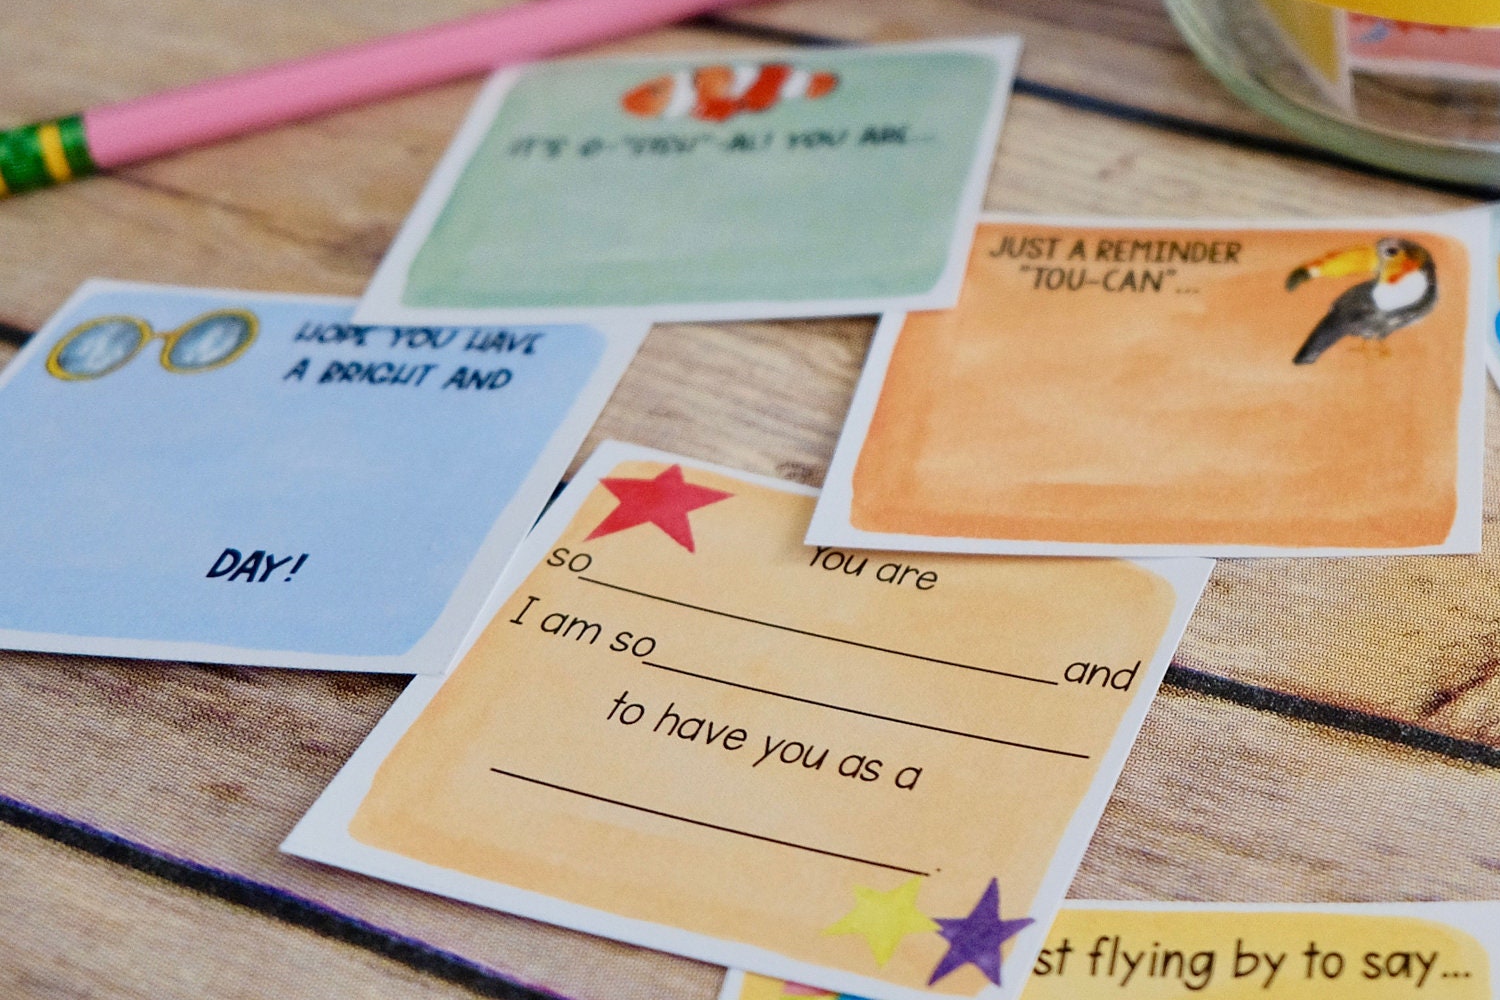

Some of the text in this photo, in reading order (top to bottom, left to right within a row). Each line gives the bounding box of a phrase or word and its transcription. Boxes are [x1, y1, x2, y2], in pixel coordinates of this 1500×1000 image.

[990, 235, 1243, 265] JUST A REMINDER
[390, 326, 458, 349] YOU
[463, 328, 546, 355] HAVE
[283, 356, 513, 390] A BRIGHT AND
[206, 547, 310, 583] DAY!
[810, 545, 938, 590] You are
[509, 595, 657, 659] I am so
[546, 545, 1142, 692] so and
[606, 690, 923, 792] to have you as a
[1087, 934, 1217, 992] flying
[1233, 937, 1287, 989] by
[1303, 940, 1345, 979] to
[1361, 949, 1473, 988] say...
